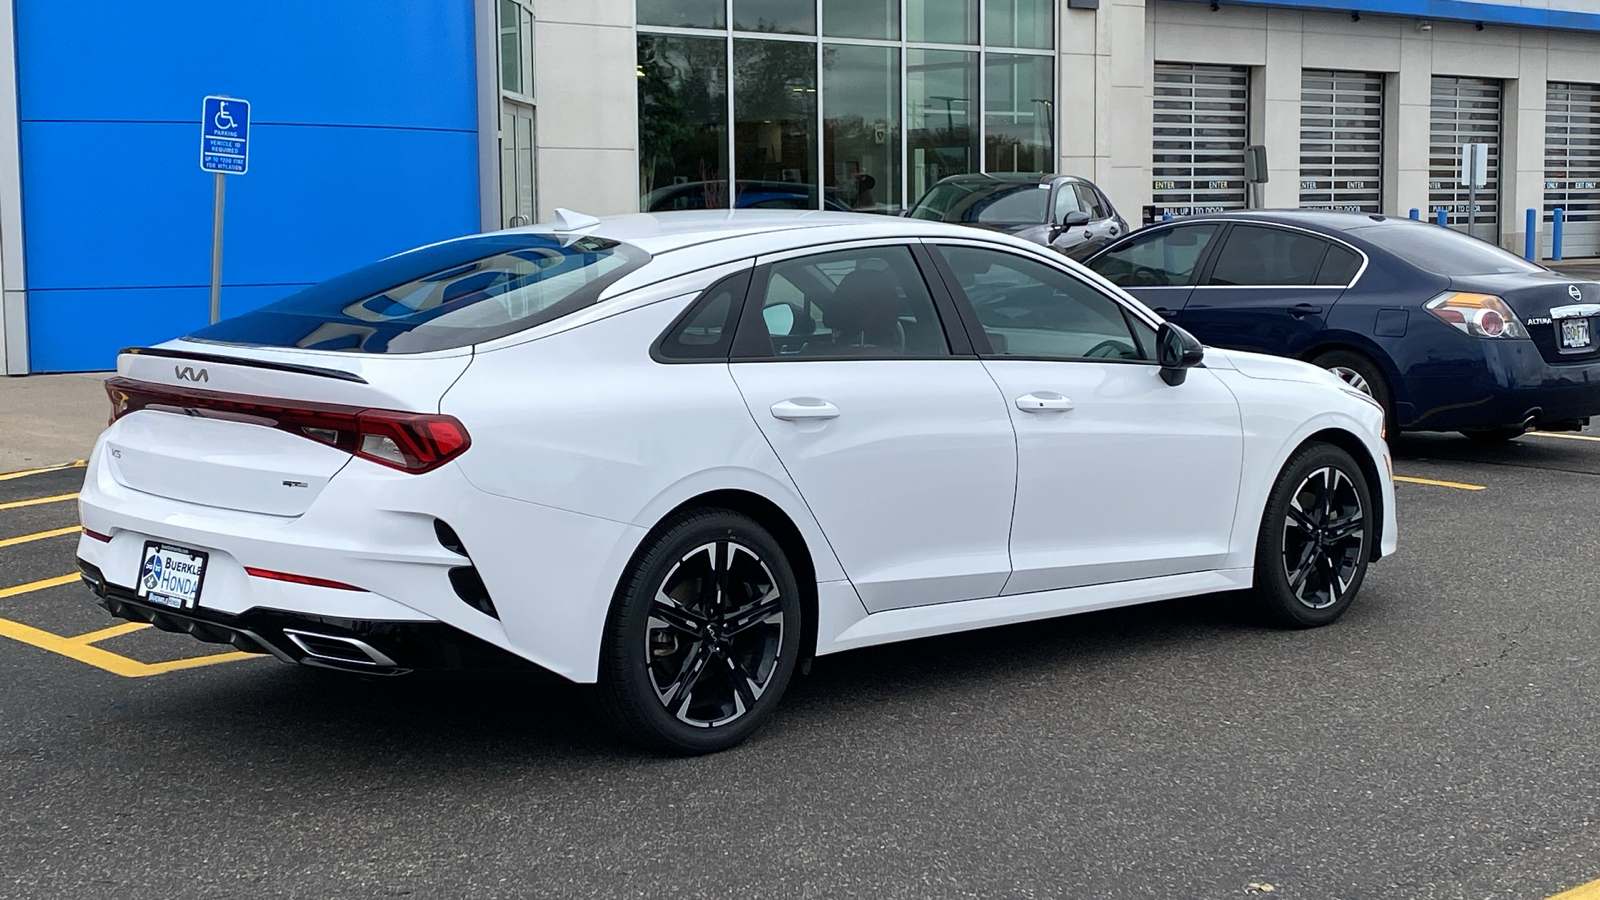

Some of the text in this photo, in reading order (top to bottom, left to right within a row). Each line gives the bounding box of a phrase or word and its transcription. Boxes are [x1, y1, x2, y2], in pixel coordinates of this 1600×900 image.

[1528, 317, 1553, 326] ALTIMA
[174, 365, 209, 383] KIA
[111, 448, 122, 459] K5
[164, 556, 202, 576] BUERKLE
[161, 569, 198, 596] HONDA
